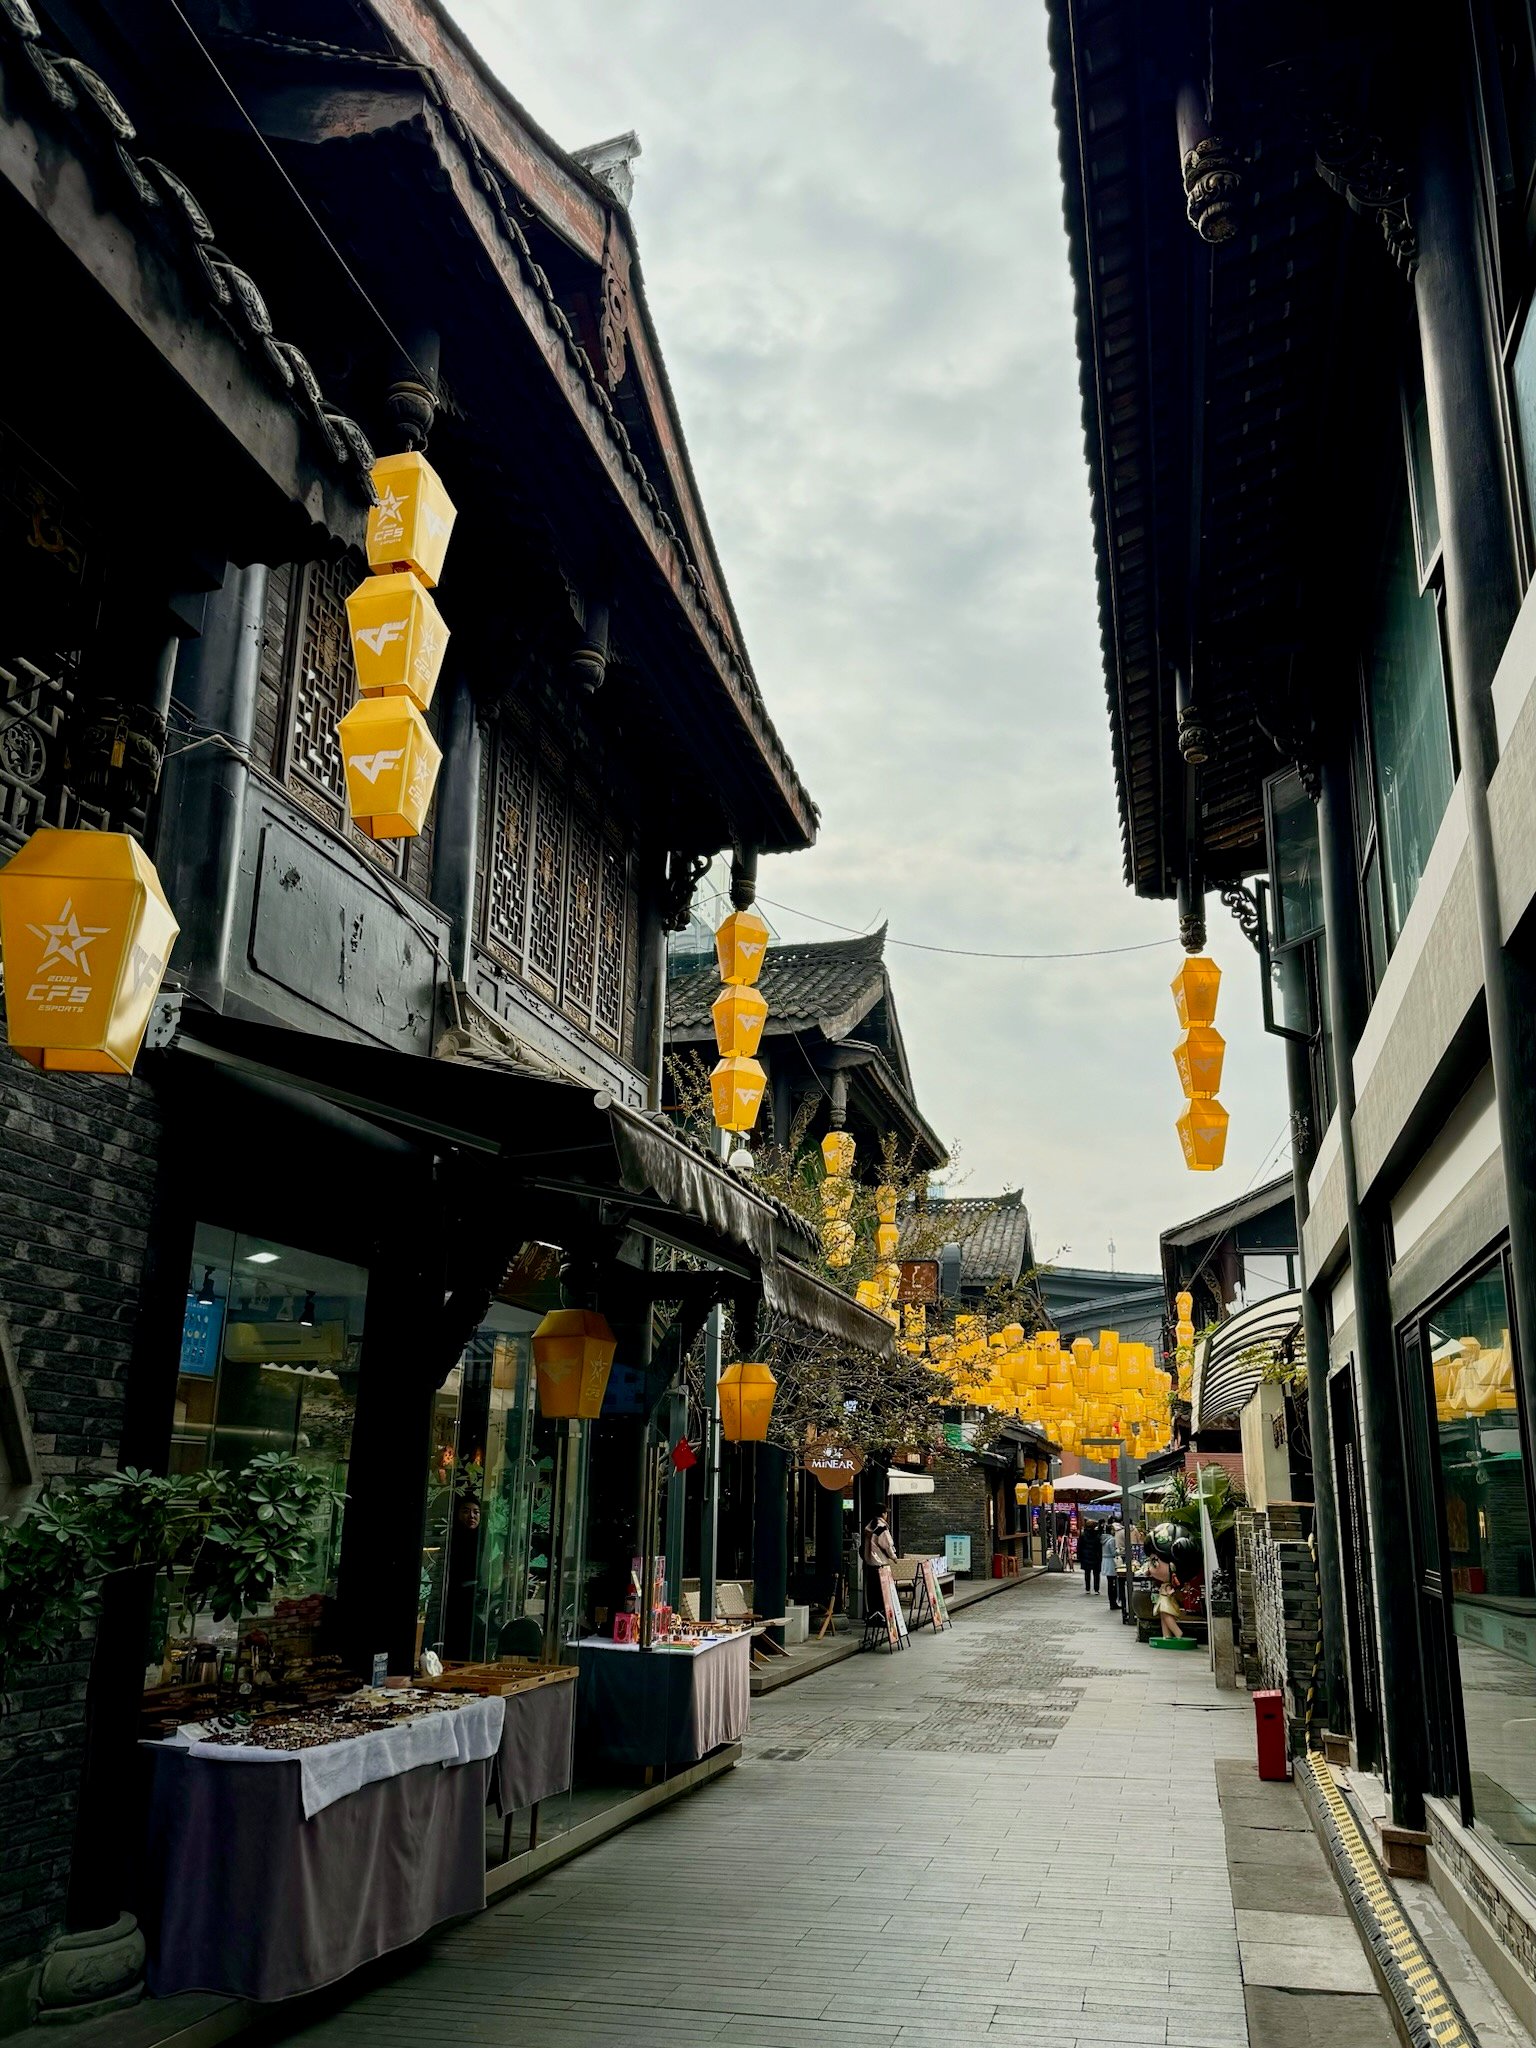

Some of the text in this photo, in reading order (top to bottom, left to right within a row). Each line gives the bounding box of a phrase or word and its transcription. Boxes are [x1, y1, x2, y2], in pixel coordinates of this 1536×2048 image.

[374, 527, 404, 542] CFS
[26, 984, 93, 1003] CFS
[38, 1005, 85, 1013] ESPORTS
